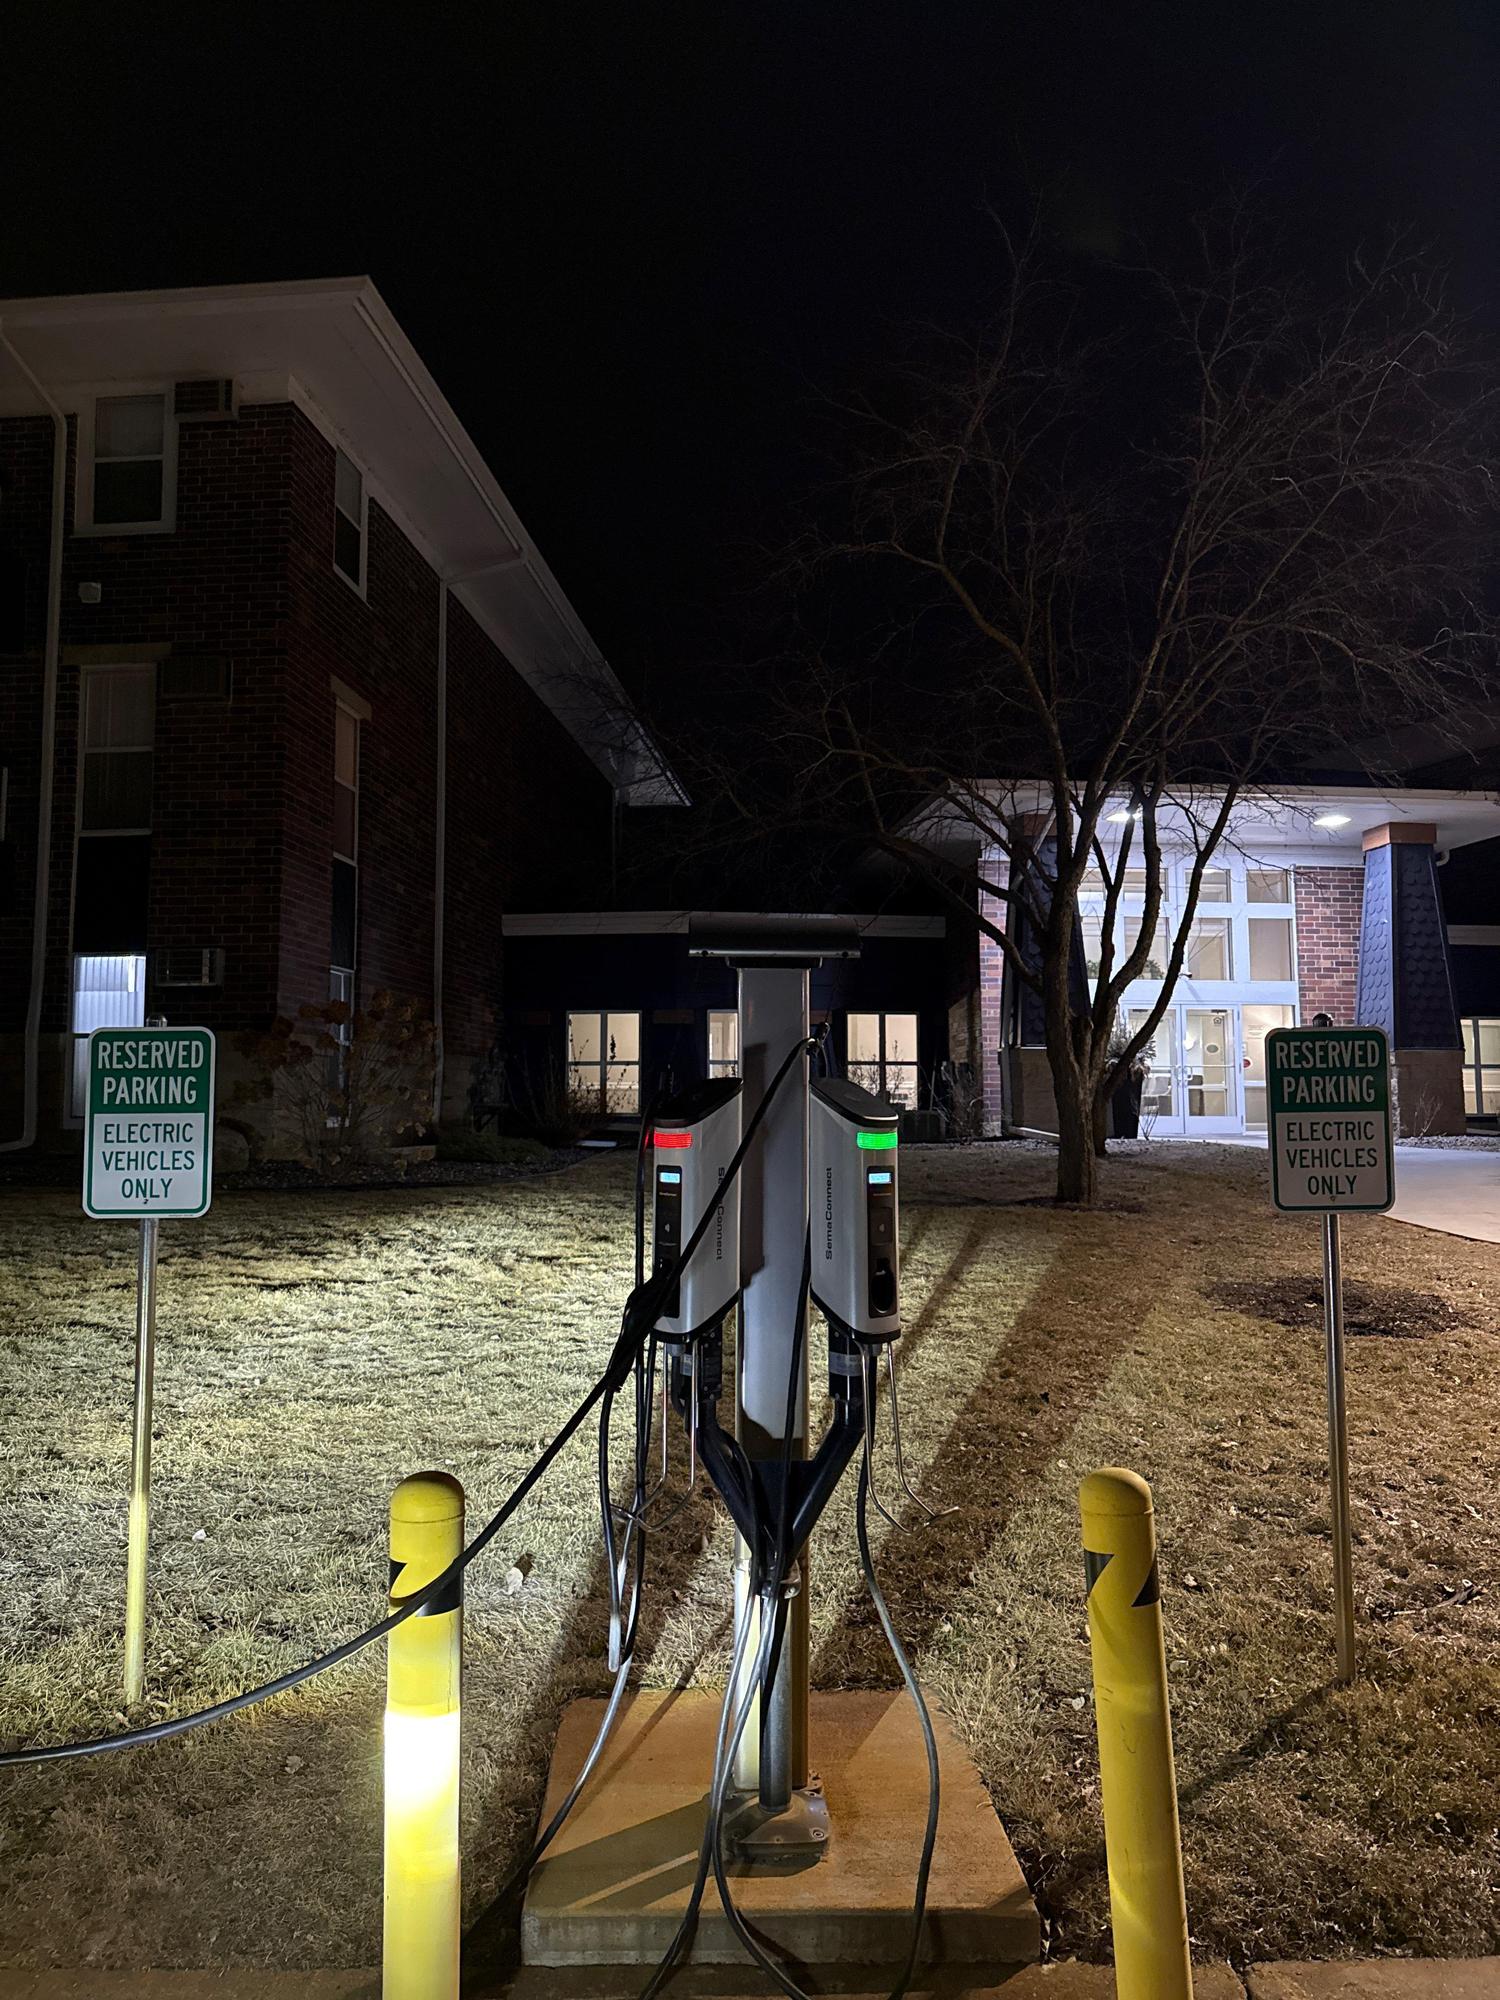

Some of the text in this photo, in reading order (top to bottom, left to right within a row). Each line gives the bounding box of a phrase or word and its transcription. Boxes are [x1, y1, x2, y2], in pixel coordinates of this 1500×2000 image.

[98, 1040, 204, 1069] RESERVED
[1276, 1040, 1380, 1069] RESERVED
[103, 1076, 197, 1105] PARKING
[1283, 1075, 1375, 1104] PARKING
[103, 1123, 194, 1143] ELECTRIC
[1287, 1121, 1375, 1141] ELECTRIC
[102, 1150, 195, 1171] VEHICLES
[1286, 1148, 1377, 1168] VEHICLES
[121, 1178, 173, 1198] ONLY
[1307, 1175, 1357, 1195] ONLY
[825, 1166, 833, 1260] SemaConnect
